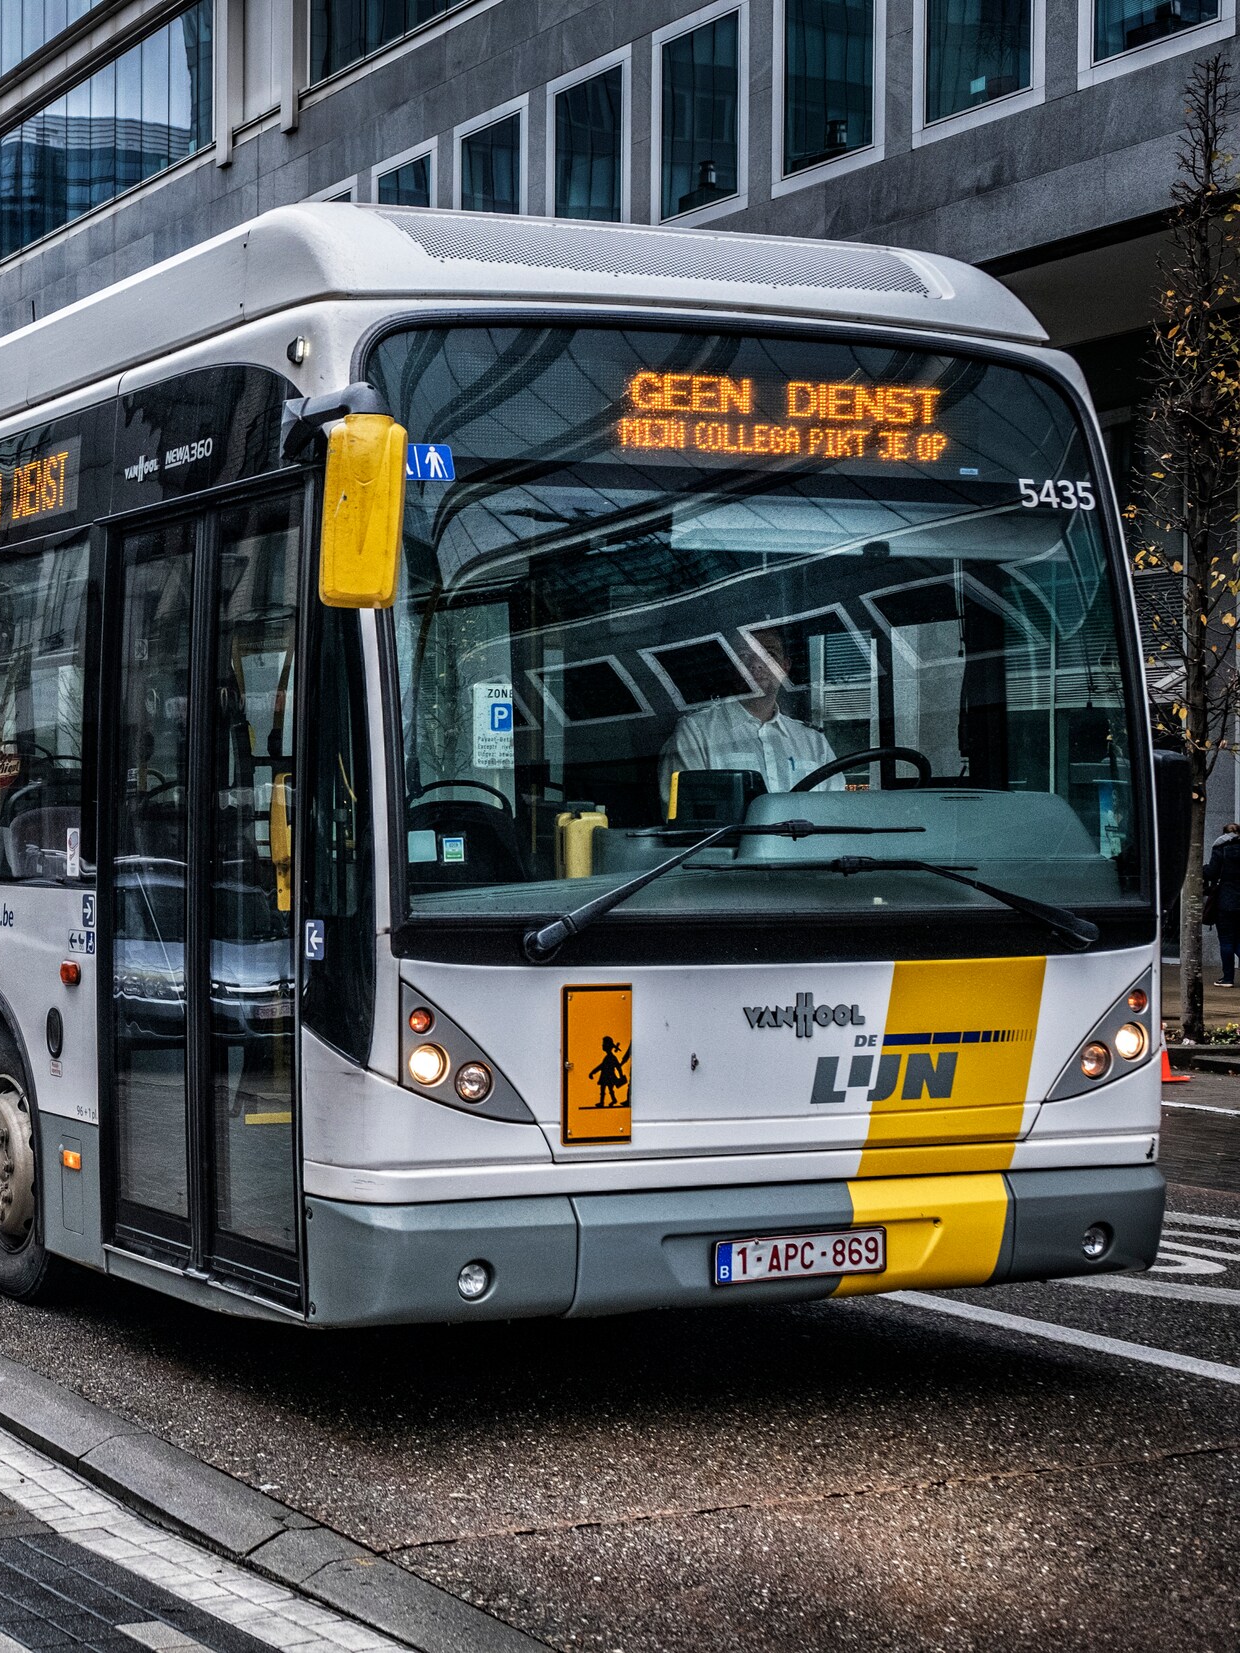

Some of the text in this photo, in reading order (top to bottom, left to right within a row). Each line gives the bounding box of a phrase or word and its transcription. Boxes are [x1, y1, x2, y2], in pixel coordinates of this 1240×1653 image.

[629, 372, 941, 424] GEEN DIENST
[617, 416, 948, 461] MIJN COLLEGA PIKT JE OP
[12, 451, 69, 519] DIENST
[1018, 478, 1096, 511] 5435
[854, 1034, 878, 1048] DE
[810, 1051, 959, 1105] LIJN
[719, 1265, 730, 1279] B
